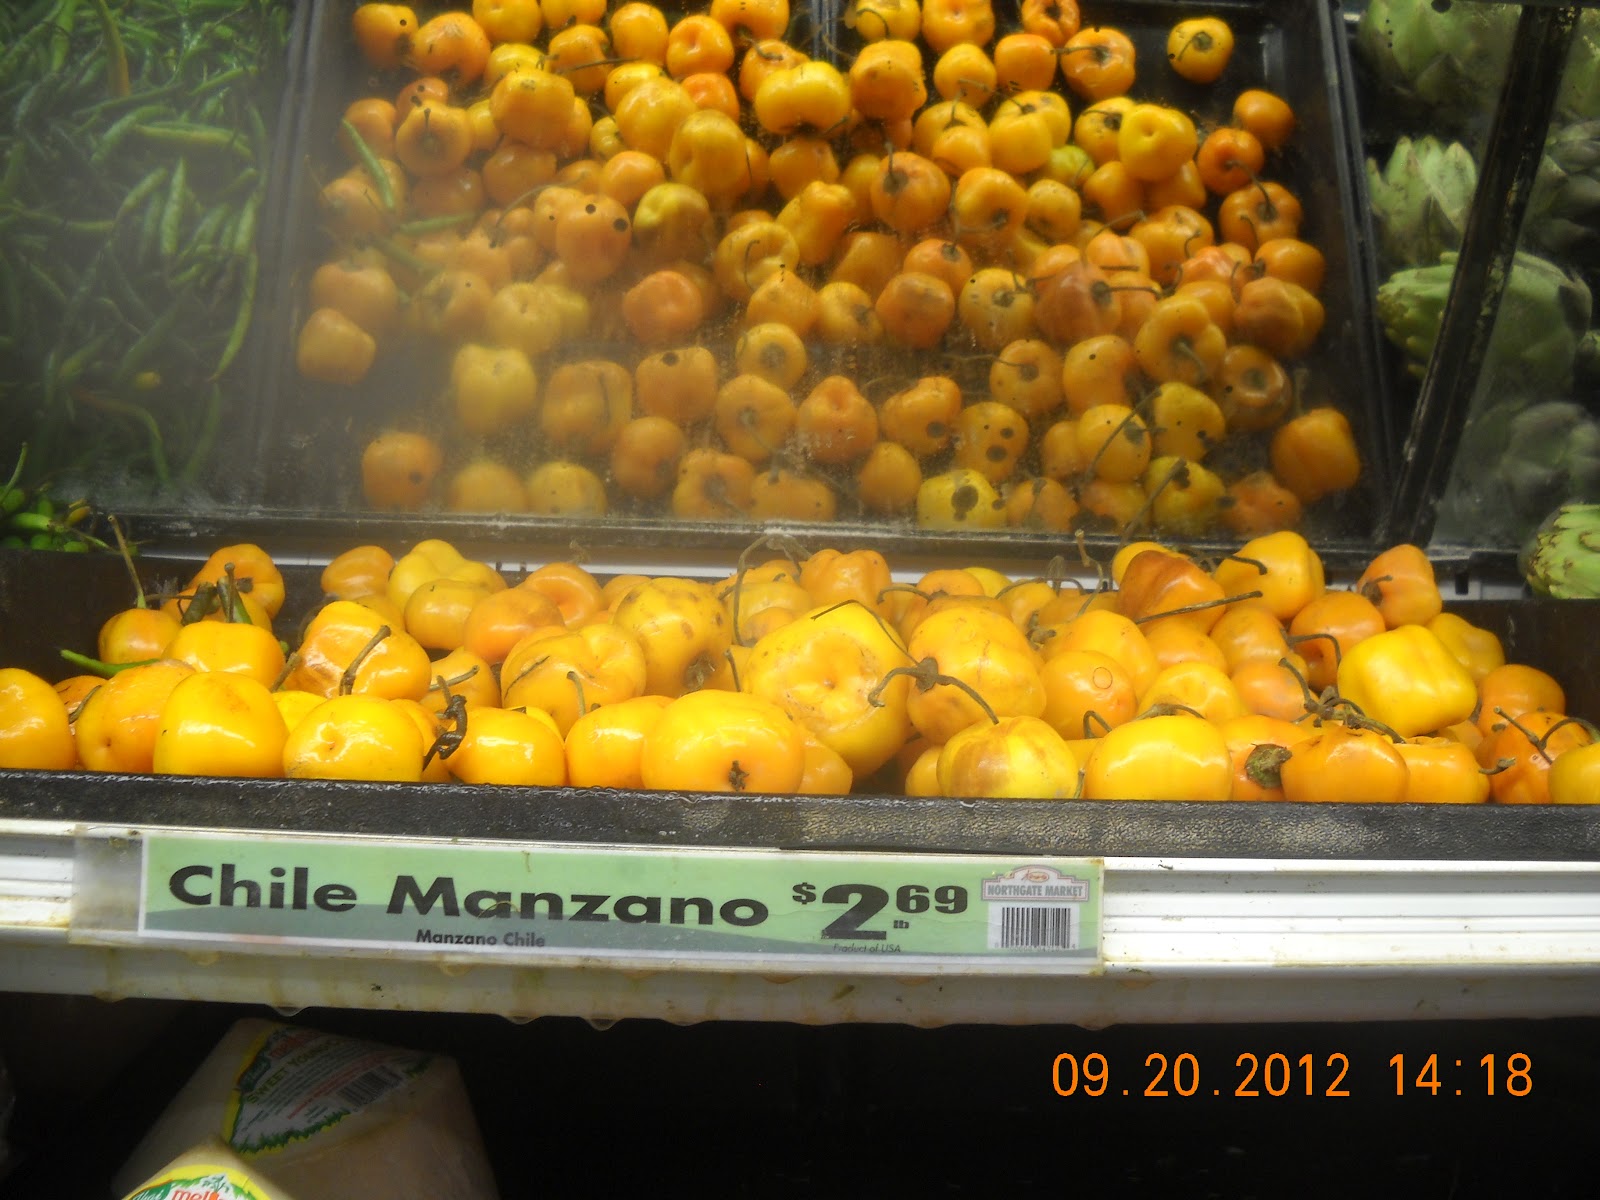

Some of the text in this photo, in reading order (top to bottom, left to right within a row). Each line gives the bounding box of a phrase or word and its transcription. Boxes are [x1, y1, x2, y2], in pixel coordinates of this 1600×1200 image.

[169, 863, 768, 928] Chile Manzano
[987, 884, 1083, 897] NORTHGATE MARKET
[415, 928, 546, 947] Manzano Chile
[833, 943, 867, 953] Product
[882, 943, 901, 953] USA
